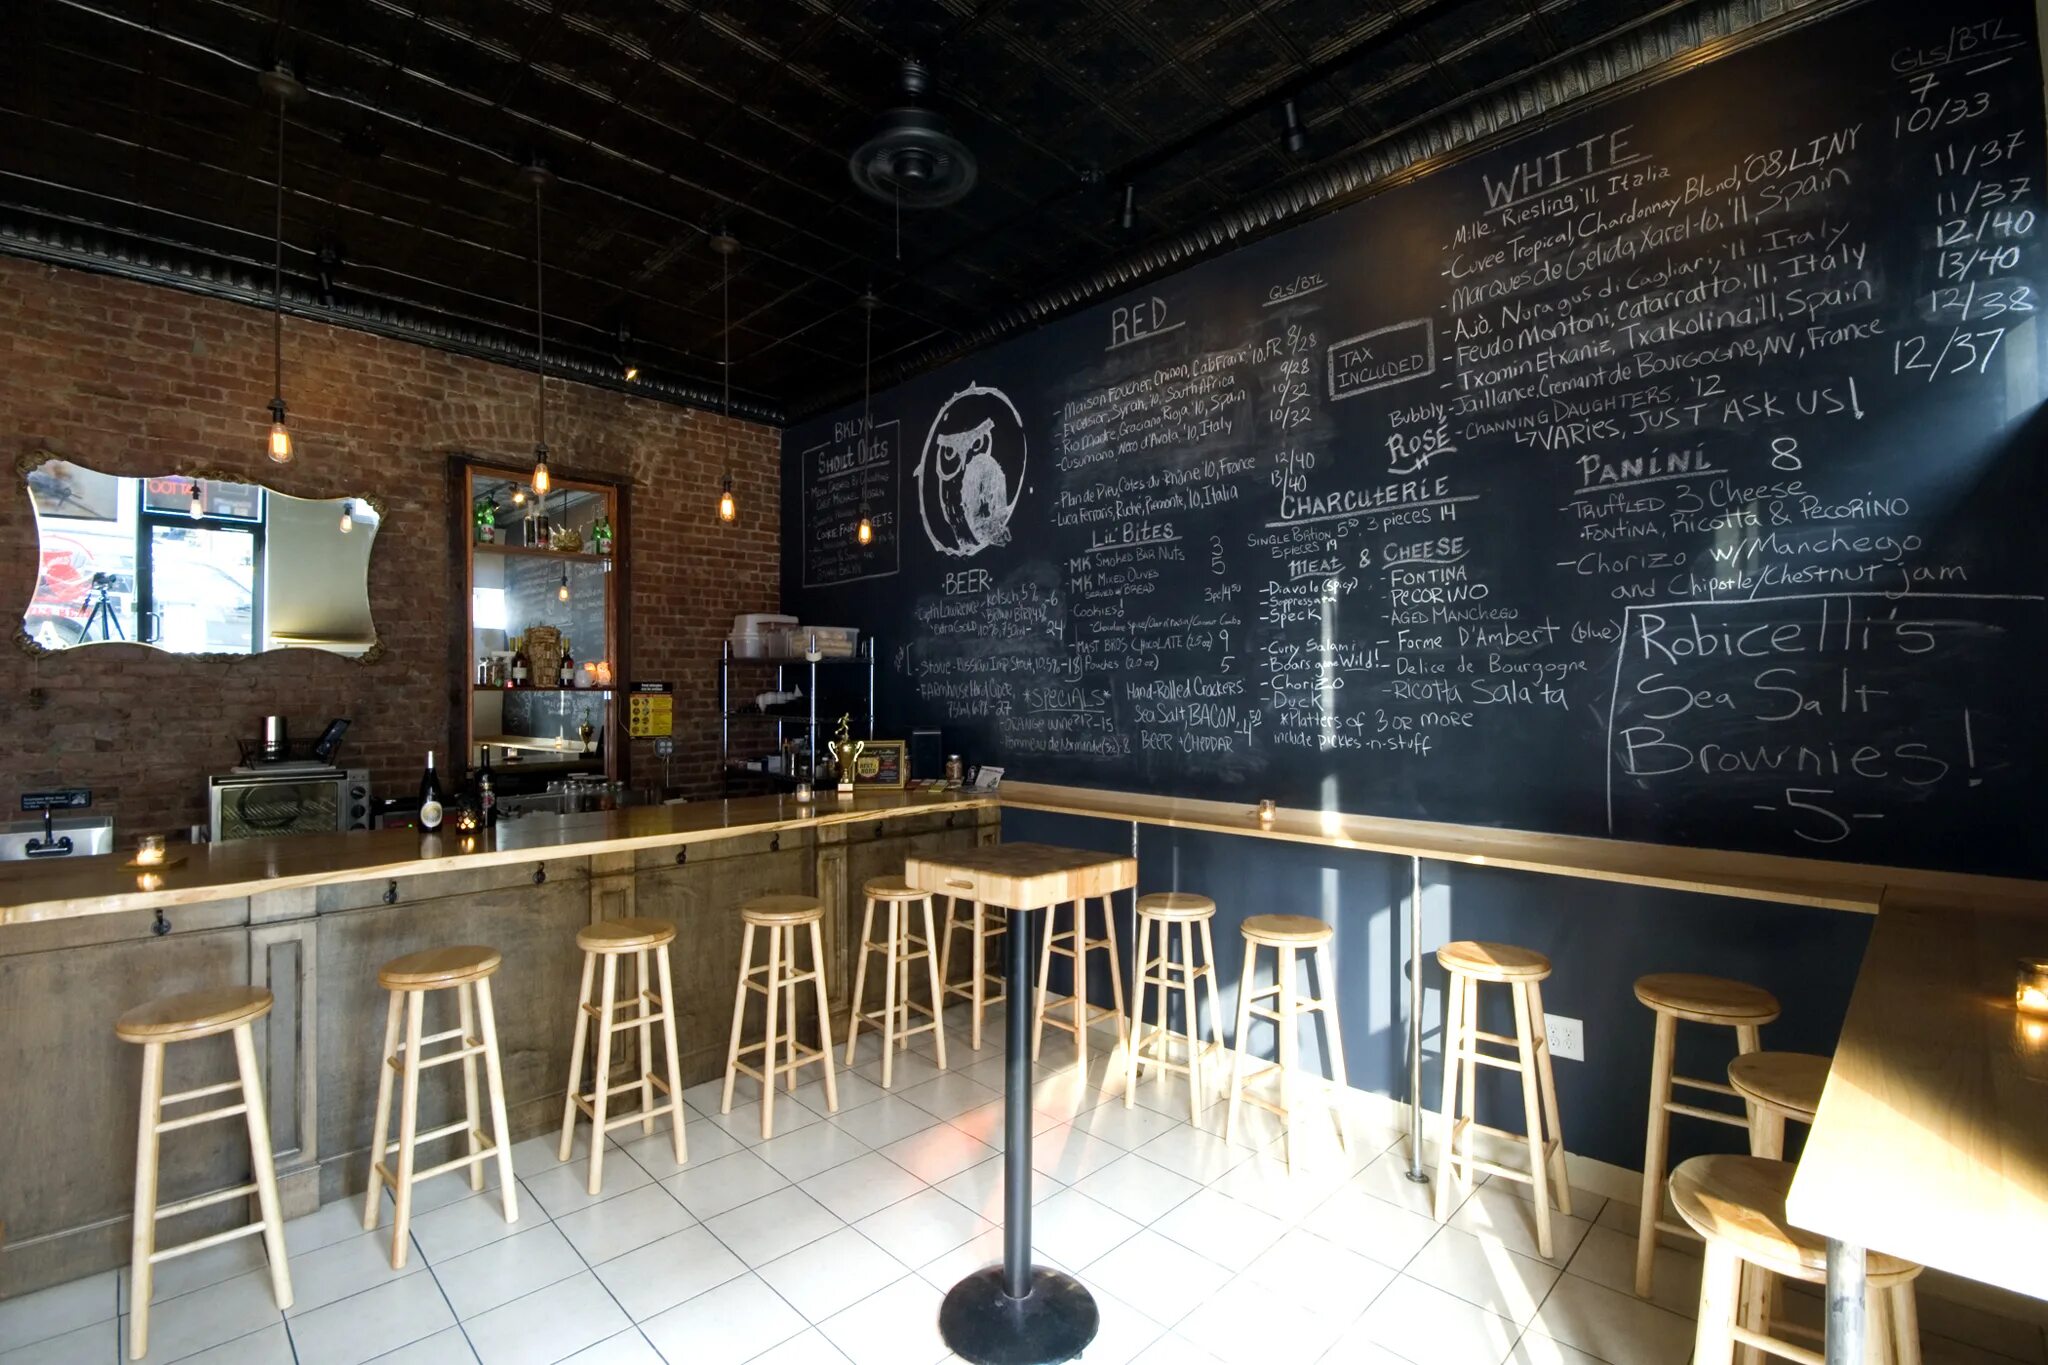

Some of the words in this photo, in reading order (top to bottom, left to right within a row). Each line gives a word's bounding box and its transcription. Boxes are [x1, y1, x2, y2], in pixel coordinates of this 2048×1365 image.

[1891, 18, 2020, 73] GLS/BTL
[1909, 72, 1940, 104] 7
[1896, 92, 1990, 139] 10/33
[1482, 124, 1641, 208] WHITE
[1935, 130, 2026, 177] 11/37
[1607, 165, 1671, 196] Italia
[1937, 178, 2031, 216] 11/37
[1506, 220, 1576, 263] Tropical,
[1578, 196, 1682, 238] Chardonnay
[1533, 260, 1562, 287] de
[1757, 167, 1850, 215] Spain
[1937, 210, 2036, 247] 12/40
[1502, 285, 1592, 329] Nuragus
[1598, 276, 1621, 298] di
[1761, 217, 1849, 251] Italy
[1938, 246, 2021, 283] 13/40
[1269, 272, 1324, 301] GLS/BTL
[1932, 280, 2034, 321] 12/38
[1457, 336, 1514, 367] Feudo
[1778, 242, 1866, 278] Italy
[1111, 296, 1167, 346] RED
[1457, 359, 1533, 391] Txomin
[1786, 279, 1873, 322] Spain
[1339, 347, 1374, 369] TAX
[1538, 367, 1607, 397] Cremant
[1608, 362, 1632, 385] de
[1806, 318, 1885, 351] France
[1894, 326, 2006, 382] 12/37
[1337, 354, 1424, 389] INCLUDED
[1165, 381, 1198, 403] South
[1199, 374, 1235, 395] Africa
[1210, 389, 1246, 412] Spain
[1272, 380, 1311, 407] 10/32
[1199, 416, 1232, 436] Italy
[1270, 403, 1313, 430] 10/32
[1630, 402, 1709, 435] JUST
[1723, 392, 1785, 424] ASK
[1219, 457, 1256, 476] France
[1275, 448, 1316, 474] 12/40
[1770, 437, 1802, 471] 8
[1202, 484, 1239, 506] Italia
[1675, 484, 1704, 513] 3
[1709, 478, 1807, 507] Cheese
[1247, 533, 1291, 548] SINGLE
[1366, 517, 1379, 531] 3
[1383, 508, 1432, 532] pieces
[1440, 503, 1456, 522] 14
[1769, 500, 1792, 526] &
[1209, 535, 1224, 556] 3
[1359, 548, 1371, 569] &
[1383, 536, 1465, 561] CHEESE
[1211, 556, 1226, 575] 5
[1391, 565, 1467, 587] FONTINA
[1576, 552, 1687, 575] Chorizo
[946, 569, 991, 595] BEER
[1268, 579, 1319, 597] Diavolo
[1611, 578, 1656, 599] and
[1885, 562, 1968, 600] jam
[1045, 619, 1063, 641] 24
[1269, 608, 1323, 629] Speck
[1391, 610, 1429, 626] AGED
[1638, 596, 1936, 665] Robicelli's
[1219, 629, 1229, 652] 9
[1305, 638, 1357, 652] Salami
[1397, 629, 1443, 653] Forme
[1457, 616, 1561, 648] D'Ambert
[1571, 618, 1622, 644] (blue)
[1220, 655, 1236, 673] 5
[1269, 656, 1311, 673] Boars
[1396, 656, 1446, 676] Delice
[1457, 654, 1474, 674] de
[1489, 653, 1588, 687] Bourgogne
[1271, 674, 1345, 691] Chorizo
[1471, 678, 1570, 711] Salata
[1636, 671, 1736, 720] Sea
[1753, 667, 1889, 721] Salt
[1134, 703, 1156, 723] Sea
[1273, 689, 1325, 712] Duck
[1346, 711, 1366, 736] of
[1375, 708, 1388, 732] 3
[1392, 716, 1413, 730] OR
[1140, 730, 1173, 751] BEER
[1273, 731, 1313, 748] include
